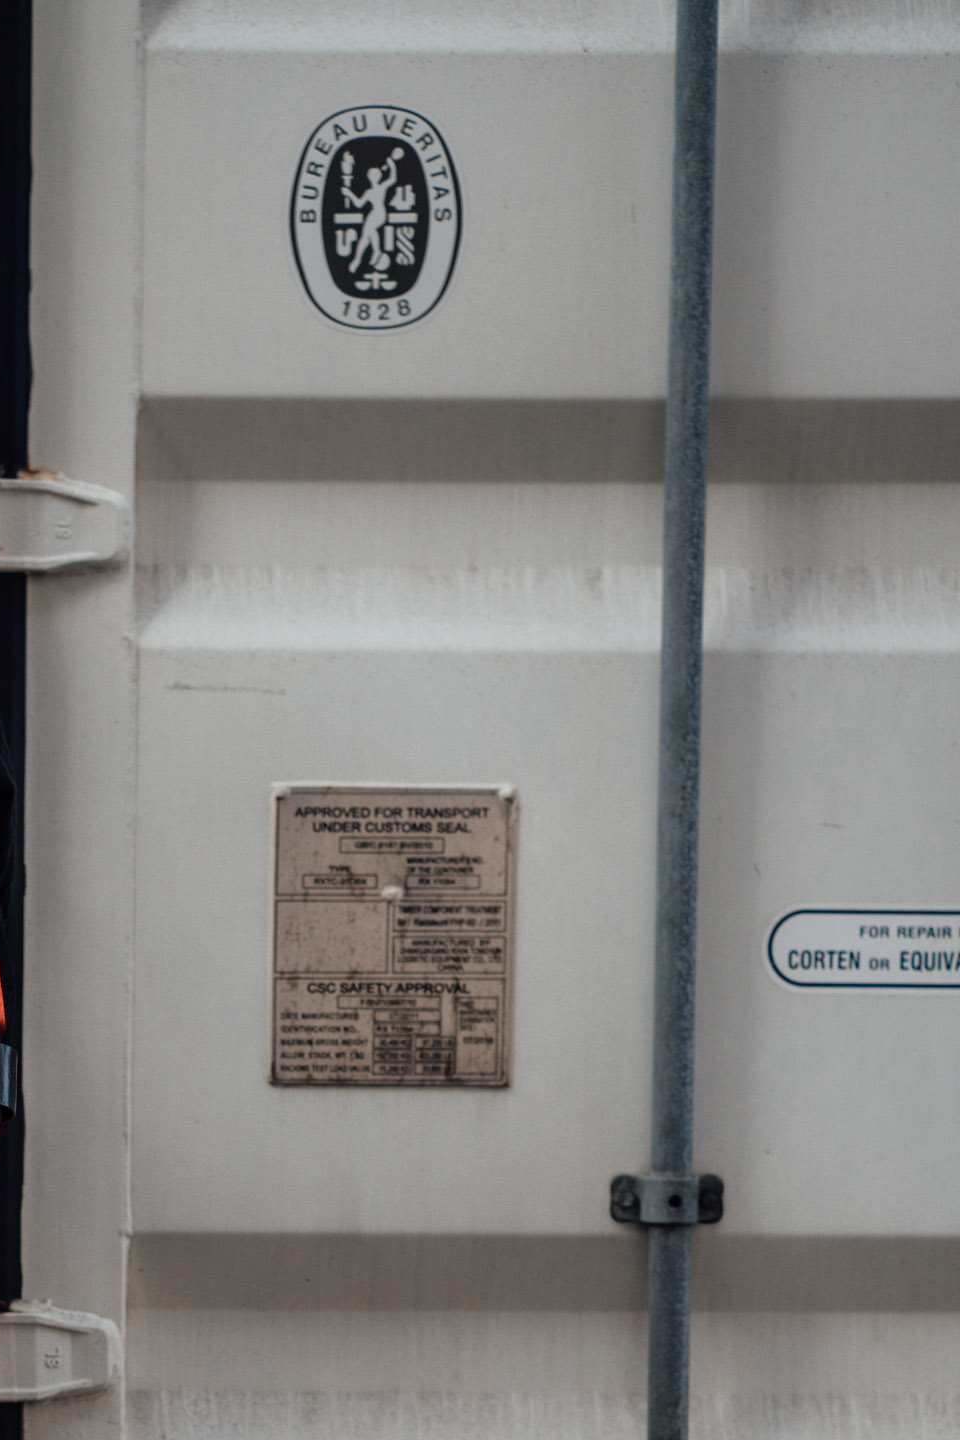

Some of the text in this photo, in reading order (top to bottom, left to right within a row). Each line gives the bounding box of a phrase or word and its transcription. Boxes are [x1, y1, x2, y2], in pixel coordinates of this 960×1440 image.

[301, 114, 452, 223] BUREAU VERITAS
[342, 299, 412, 322] 1828
[294, 806, 490, 819] APPROVED FOR TRANSPORT
[313, 822, 361, 834] UNDER
[365, 822, 433, 834] CUSTOMS
[859, 925, 952, 939] FOR REPAIR
[788, 949, 861, 970] CORTEN
[307, 983, 470, 994] CSC SAFETY APPROVAL
